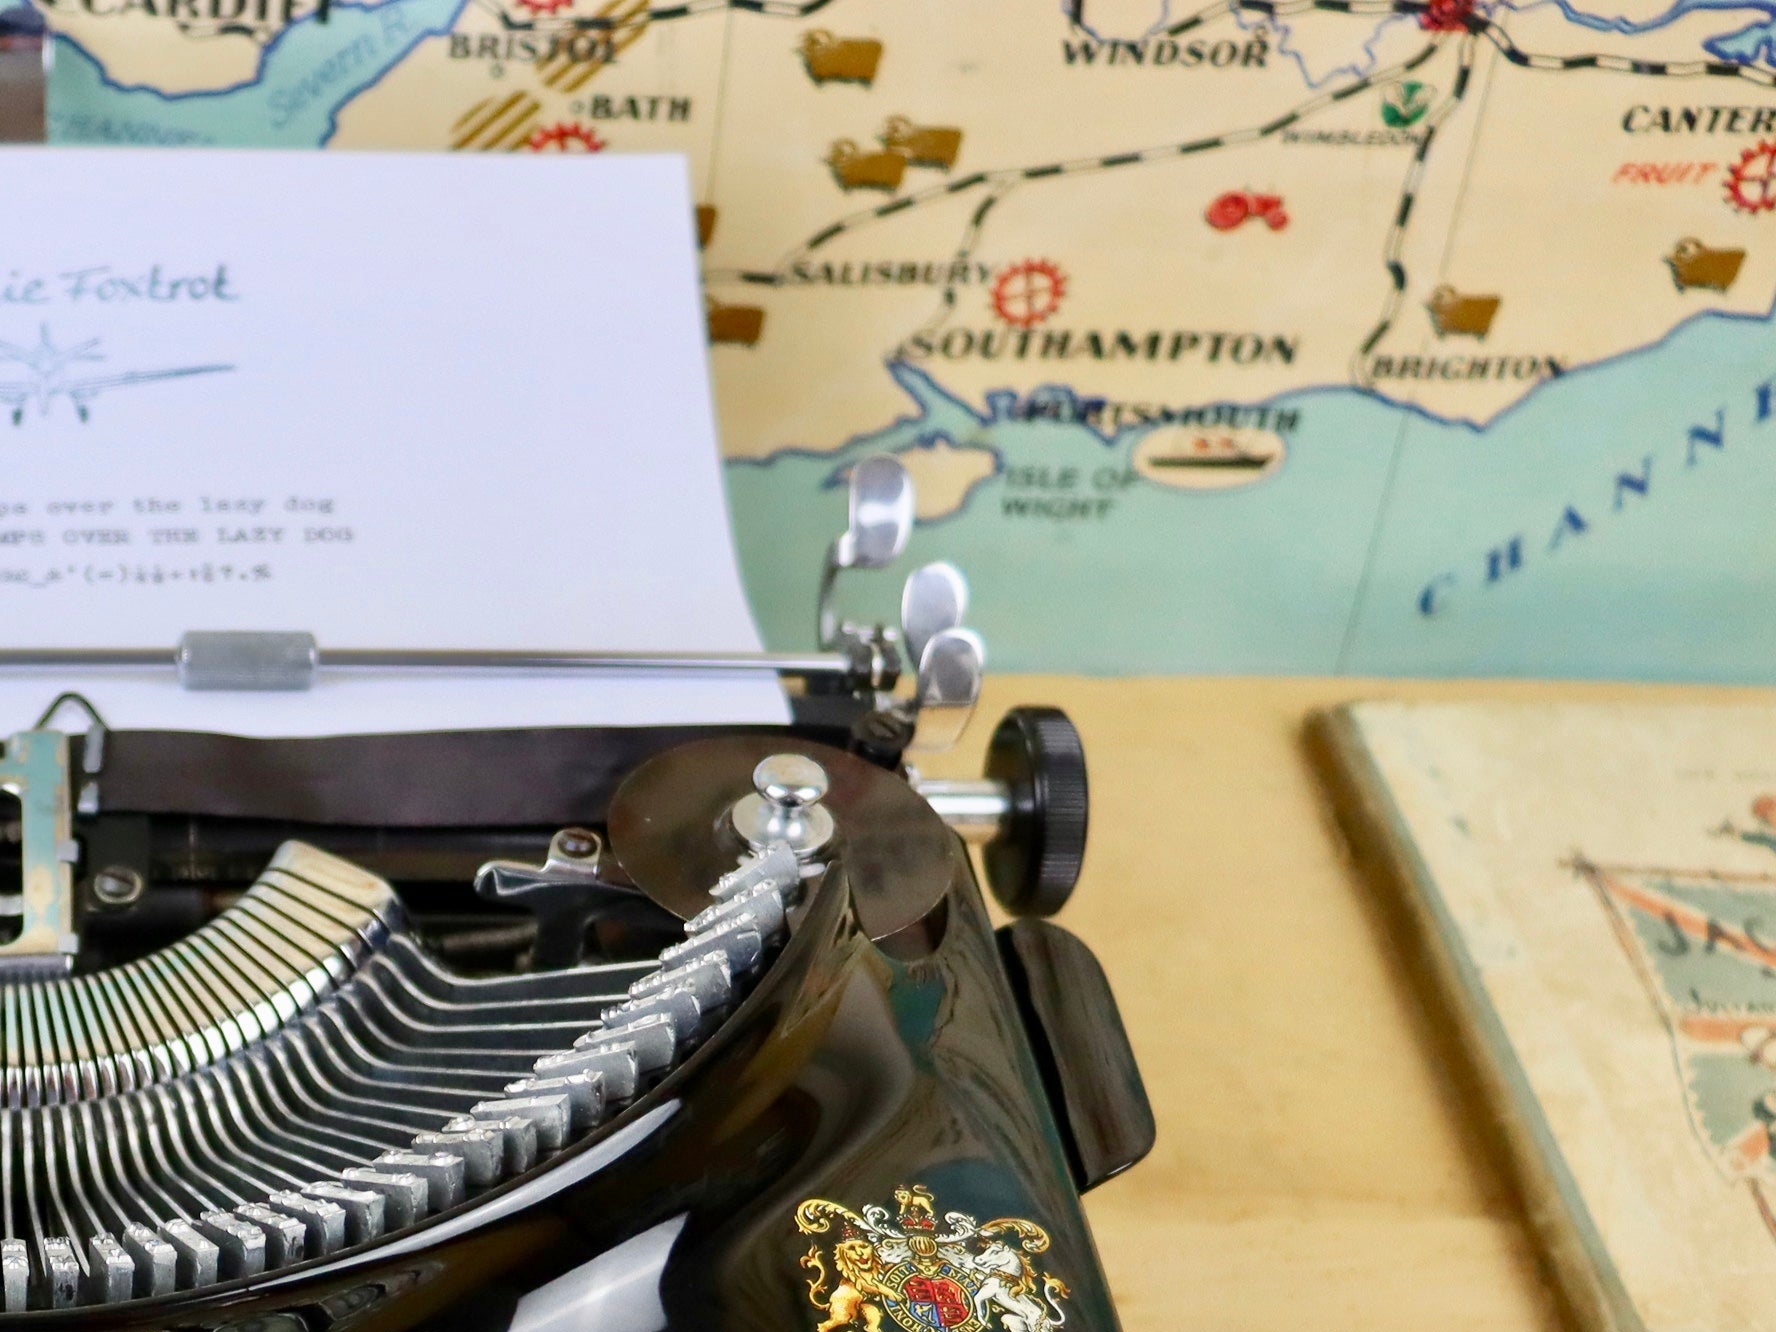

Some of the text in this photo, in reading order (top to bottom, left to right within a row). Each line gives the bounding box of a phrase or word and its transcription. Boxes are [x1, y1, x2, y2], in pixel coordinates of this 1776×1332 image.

[450, 32, 618, 63] BRISTOL
[1062, 38, 1270, 68] WINDSOR
[591, 94, 690, 121] BATH
[60, 264, 243, 304] Foxtrot
[789, 259, 995, 288] SALISBURY
[908, 328, 1300, 364] SOUTHAMPTON
[1371, 354, 1566, 381] BRIGHTON
